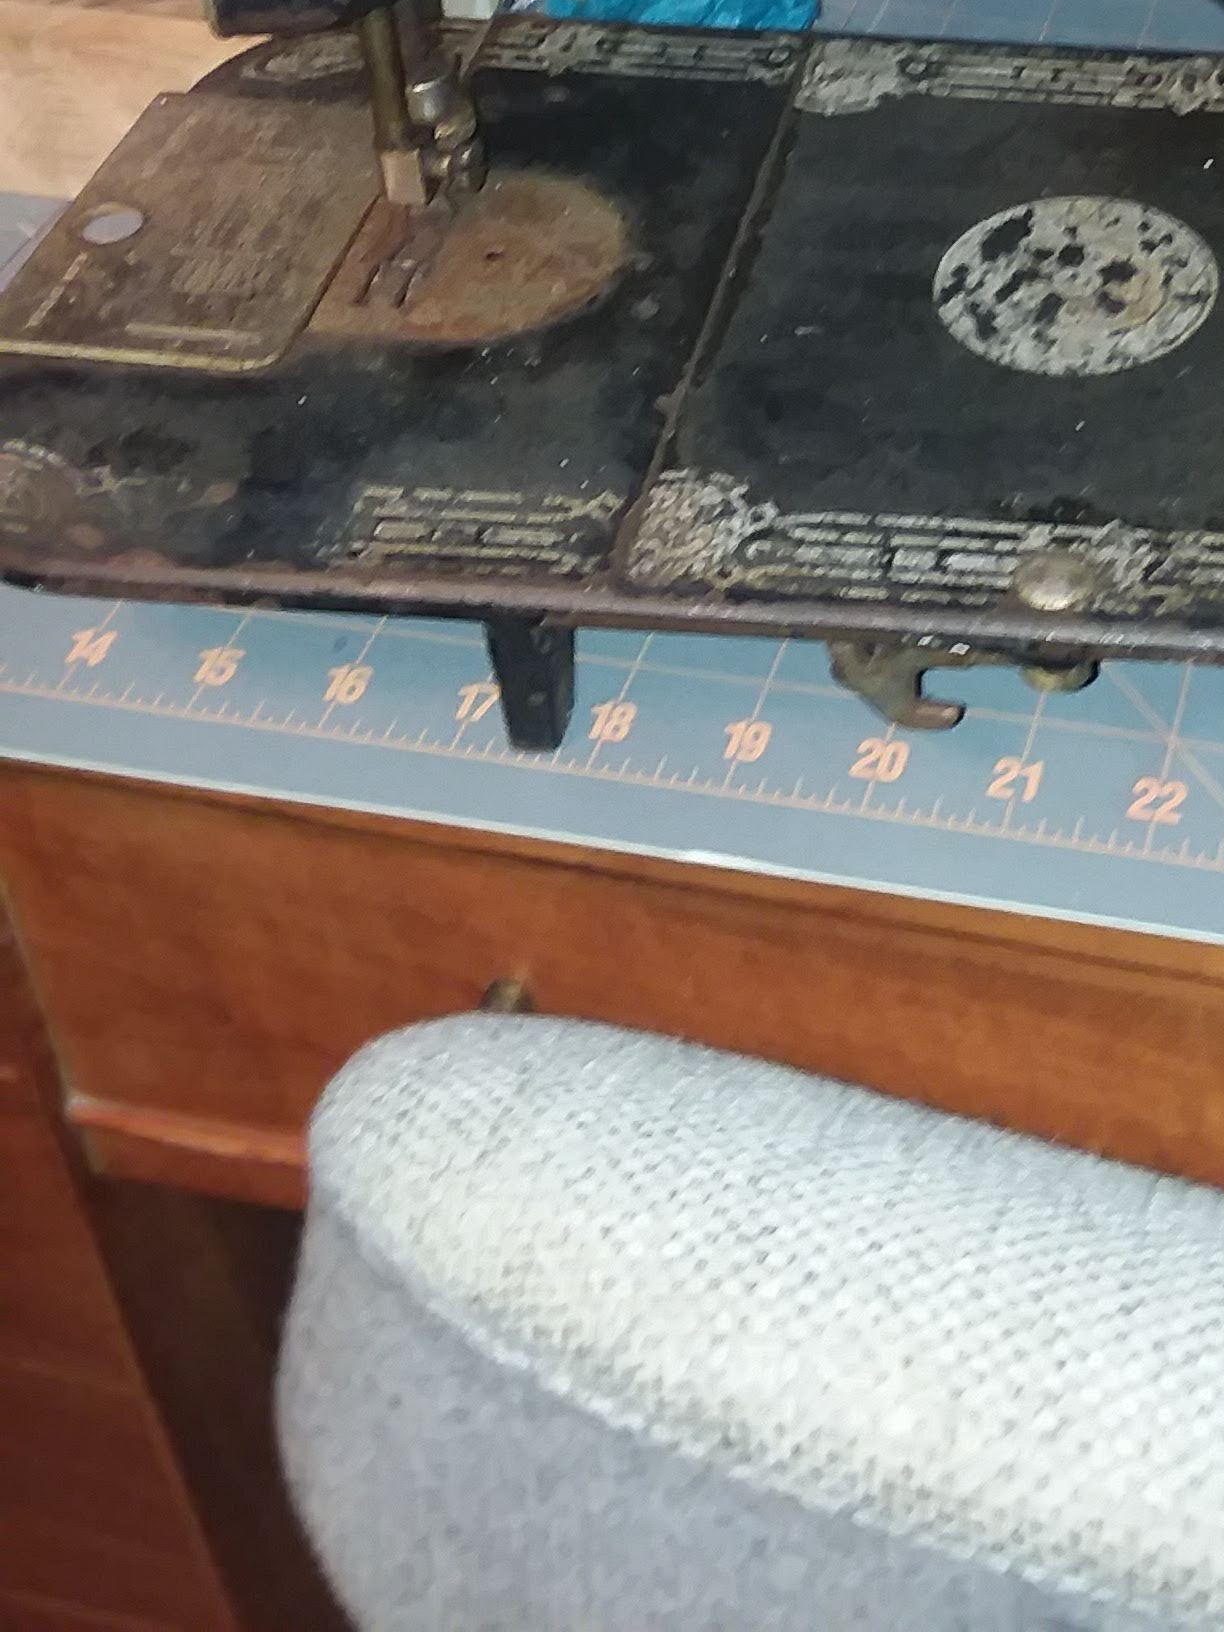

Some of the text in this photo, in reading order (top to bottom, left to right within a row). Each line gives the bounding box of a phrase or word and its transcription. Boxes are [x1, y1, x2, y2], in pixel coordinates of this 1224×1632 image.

[67, 629, 116, 665] 14
[196, 648, 245, 685] 15
[324, 666, 373, 703] 16
[457, 683, 500, 721] 17
[590, 703, 637, 741] 18
[725, 722, 771, 762] 19
[851, 739, 909, 782] 20
[987, 758, 1044, 802] 21
[1128, 778, 1188, 823] 22
